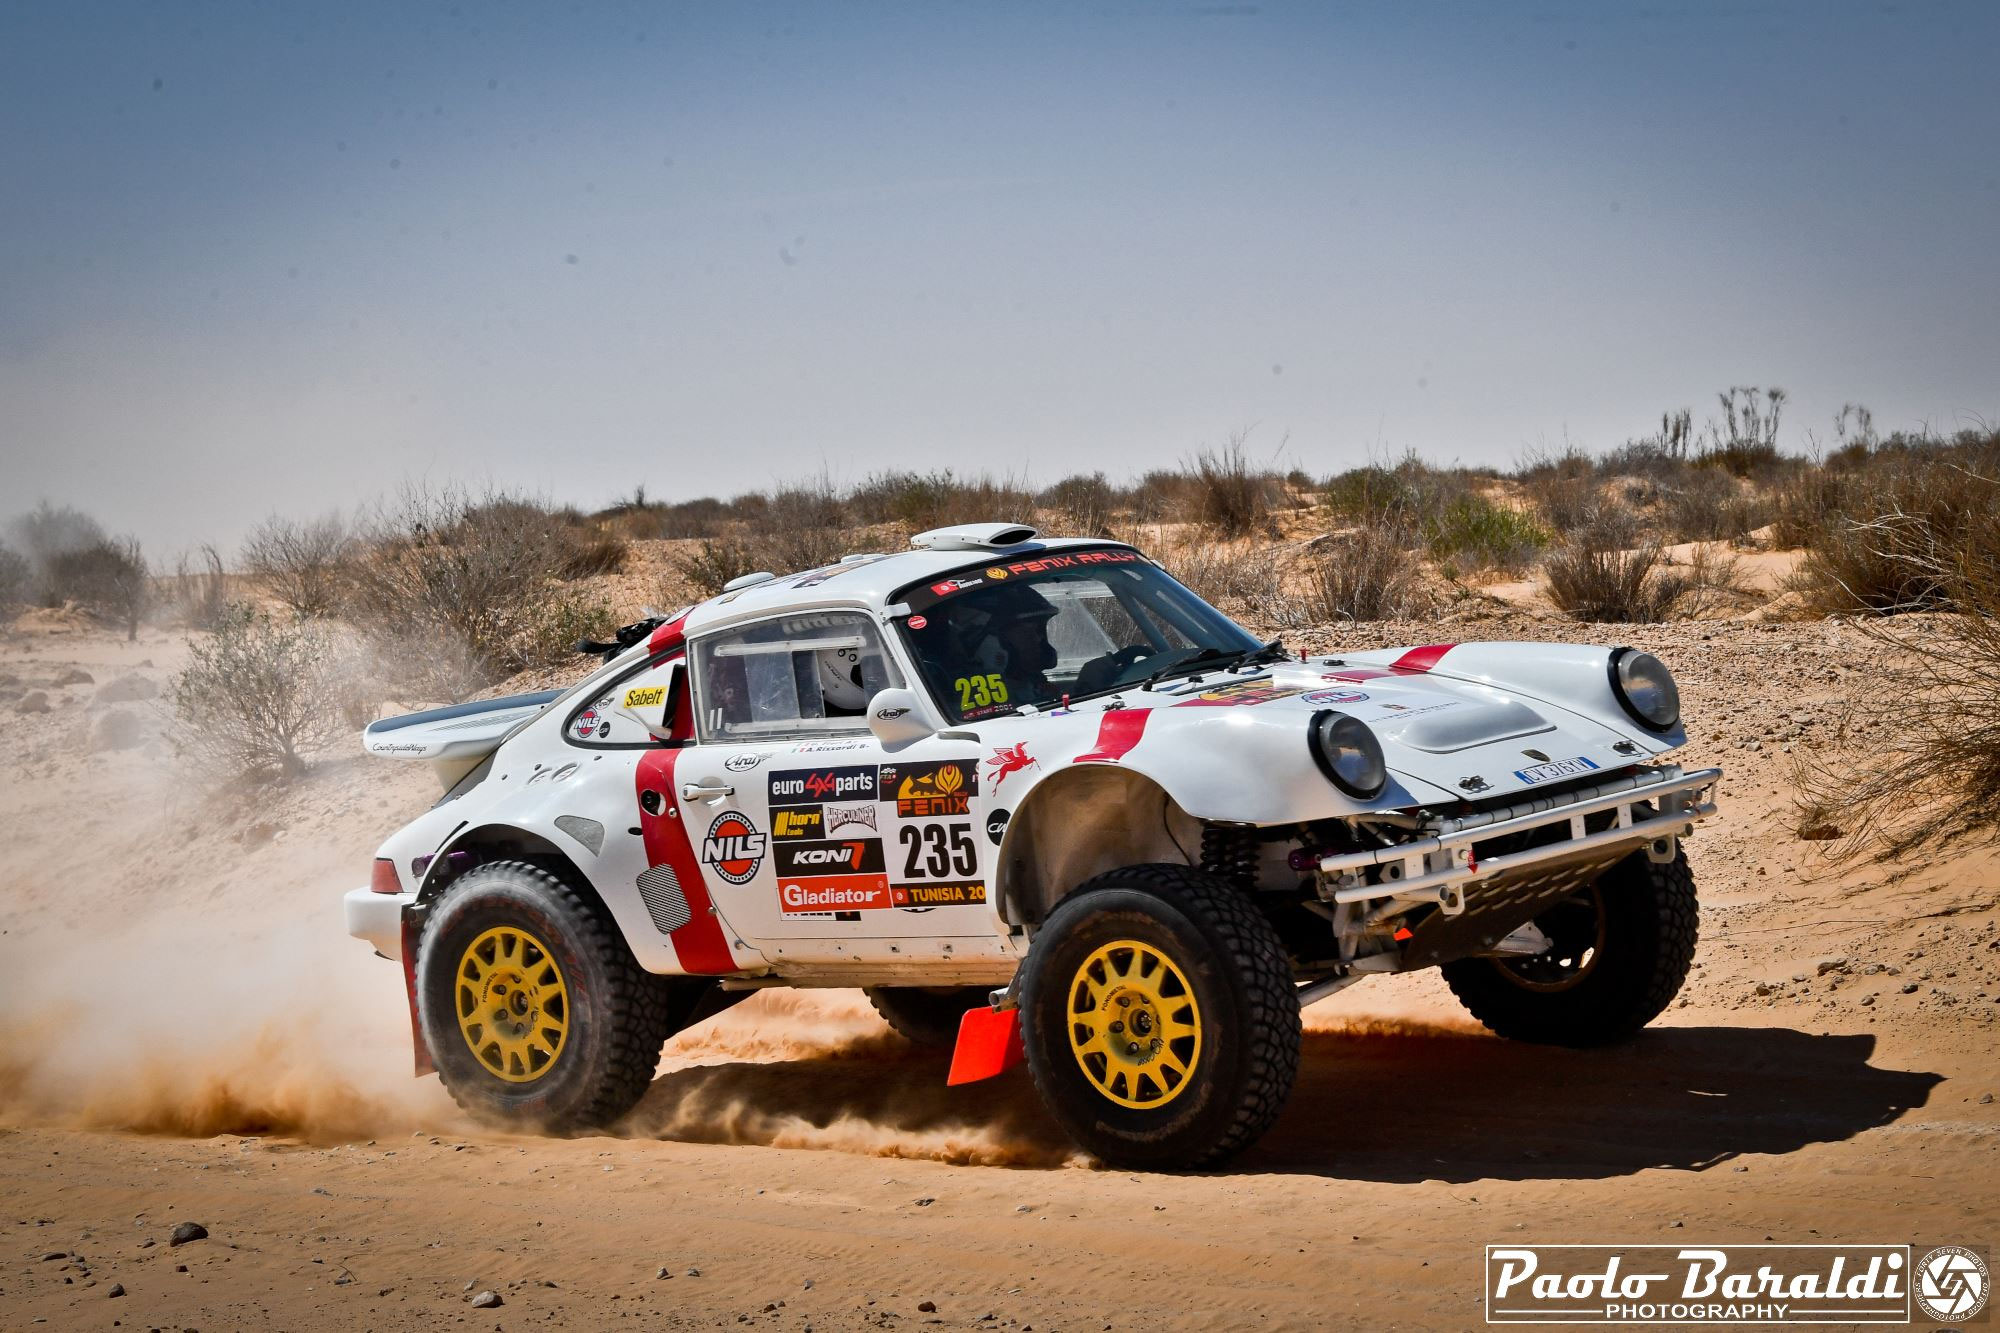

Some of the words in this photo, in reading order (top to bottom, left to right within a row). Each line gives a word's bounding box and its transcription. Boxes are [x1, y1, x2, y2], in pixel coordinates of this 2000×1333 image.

[1008, 556, 1078, 575] FENIX
[1076, 552, 1135, 564] RALLY
[626, 689, 663, 706] Sabelt
[955, 674, 1008, 711] 235
[574, 716, 600, 730] NILS
[728, 753, 757, 767] Arai
[1523, 769, 1547, 781] CV
[898, 796, 970, 817] FENIX
[789, 811, 820, 826] horn
[827, 805, 878, 833] HERCULINER
[703, 834, 766, 863] NILS
[793, 848, 852, 864] KONI
[899, 823, 977, 878] 235
[783, 884, 881, 906] Gladiator
[910, 887, 964, 902] TUNISIA
